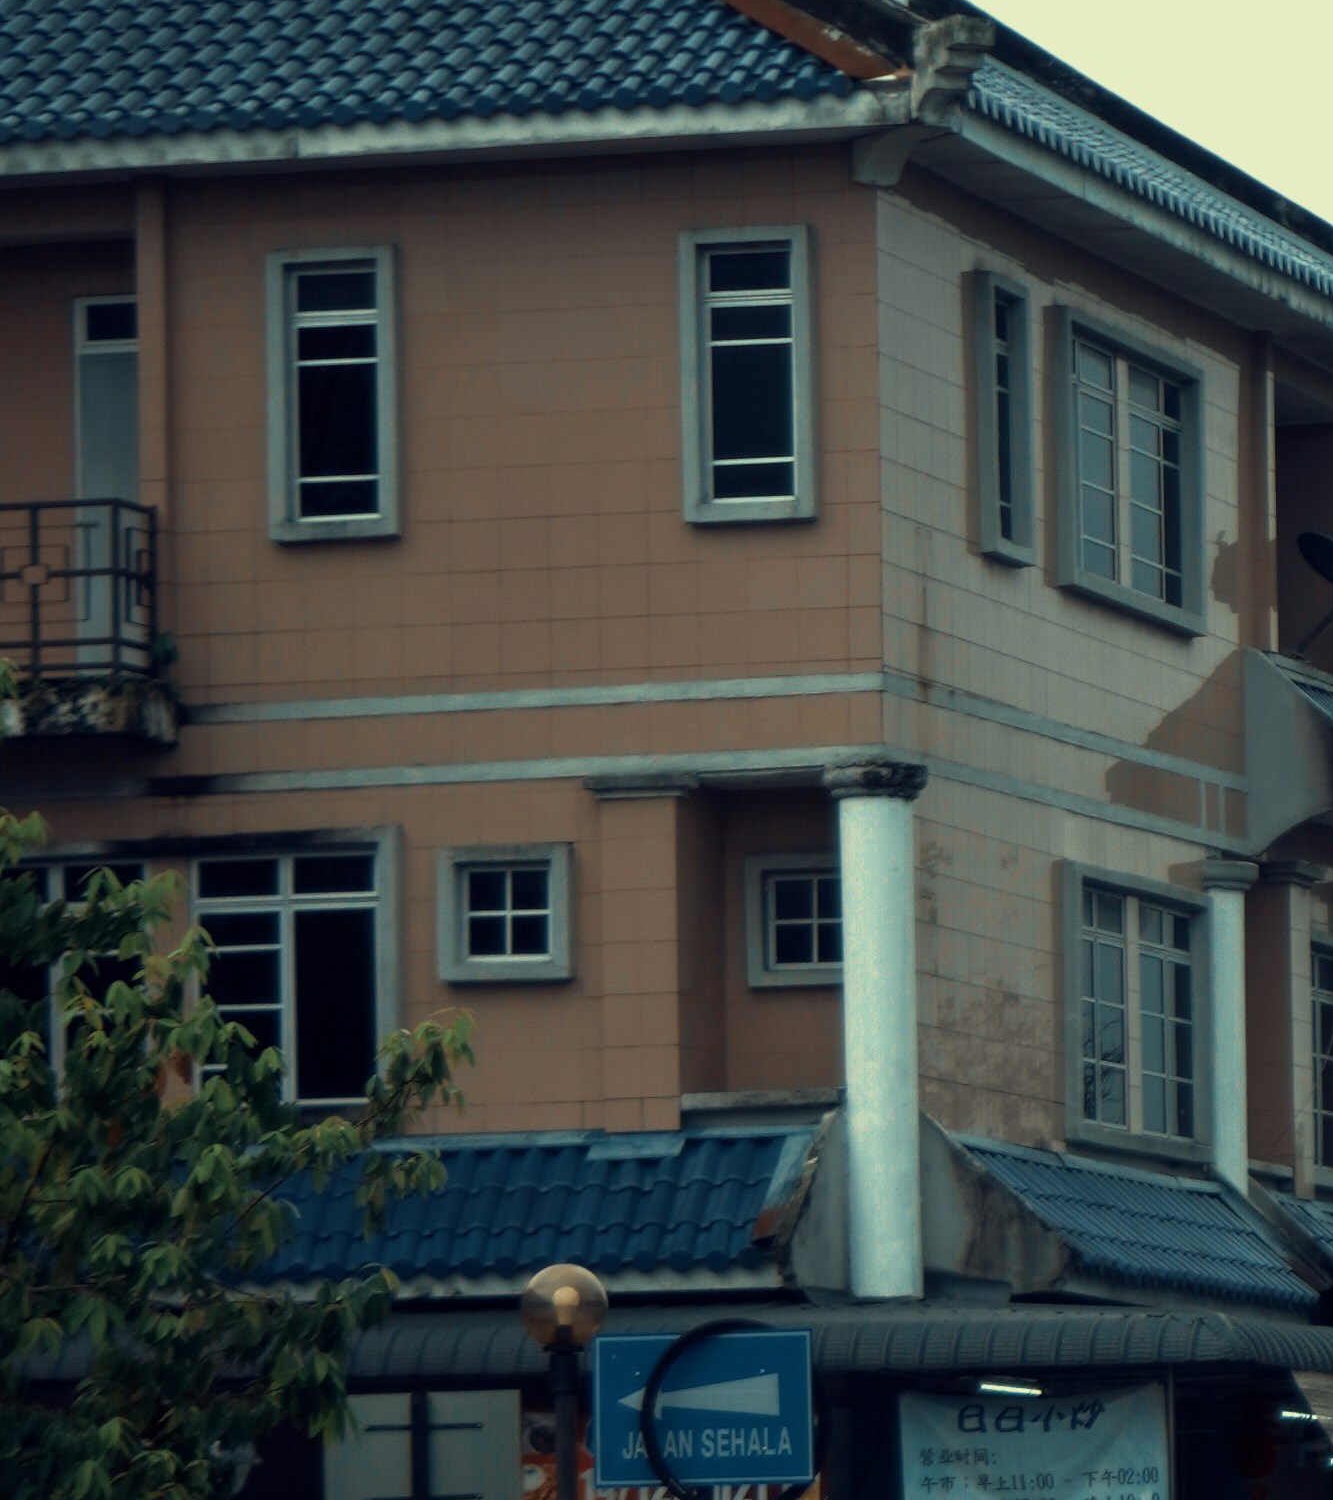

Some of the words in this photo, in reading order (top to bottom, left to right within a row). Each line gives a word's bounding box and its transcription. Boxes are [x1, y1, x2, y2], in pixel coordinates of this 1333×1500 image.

[958, 1396, 1106, 1434] 日日小炒
[622, 1428, 694, 1461] JAAN
[700, 1426, 793, 1458] SEHALA
